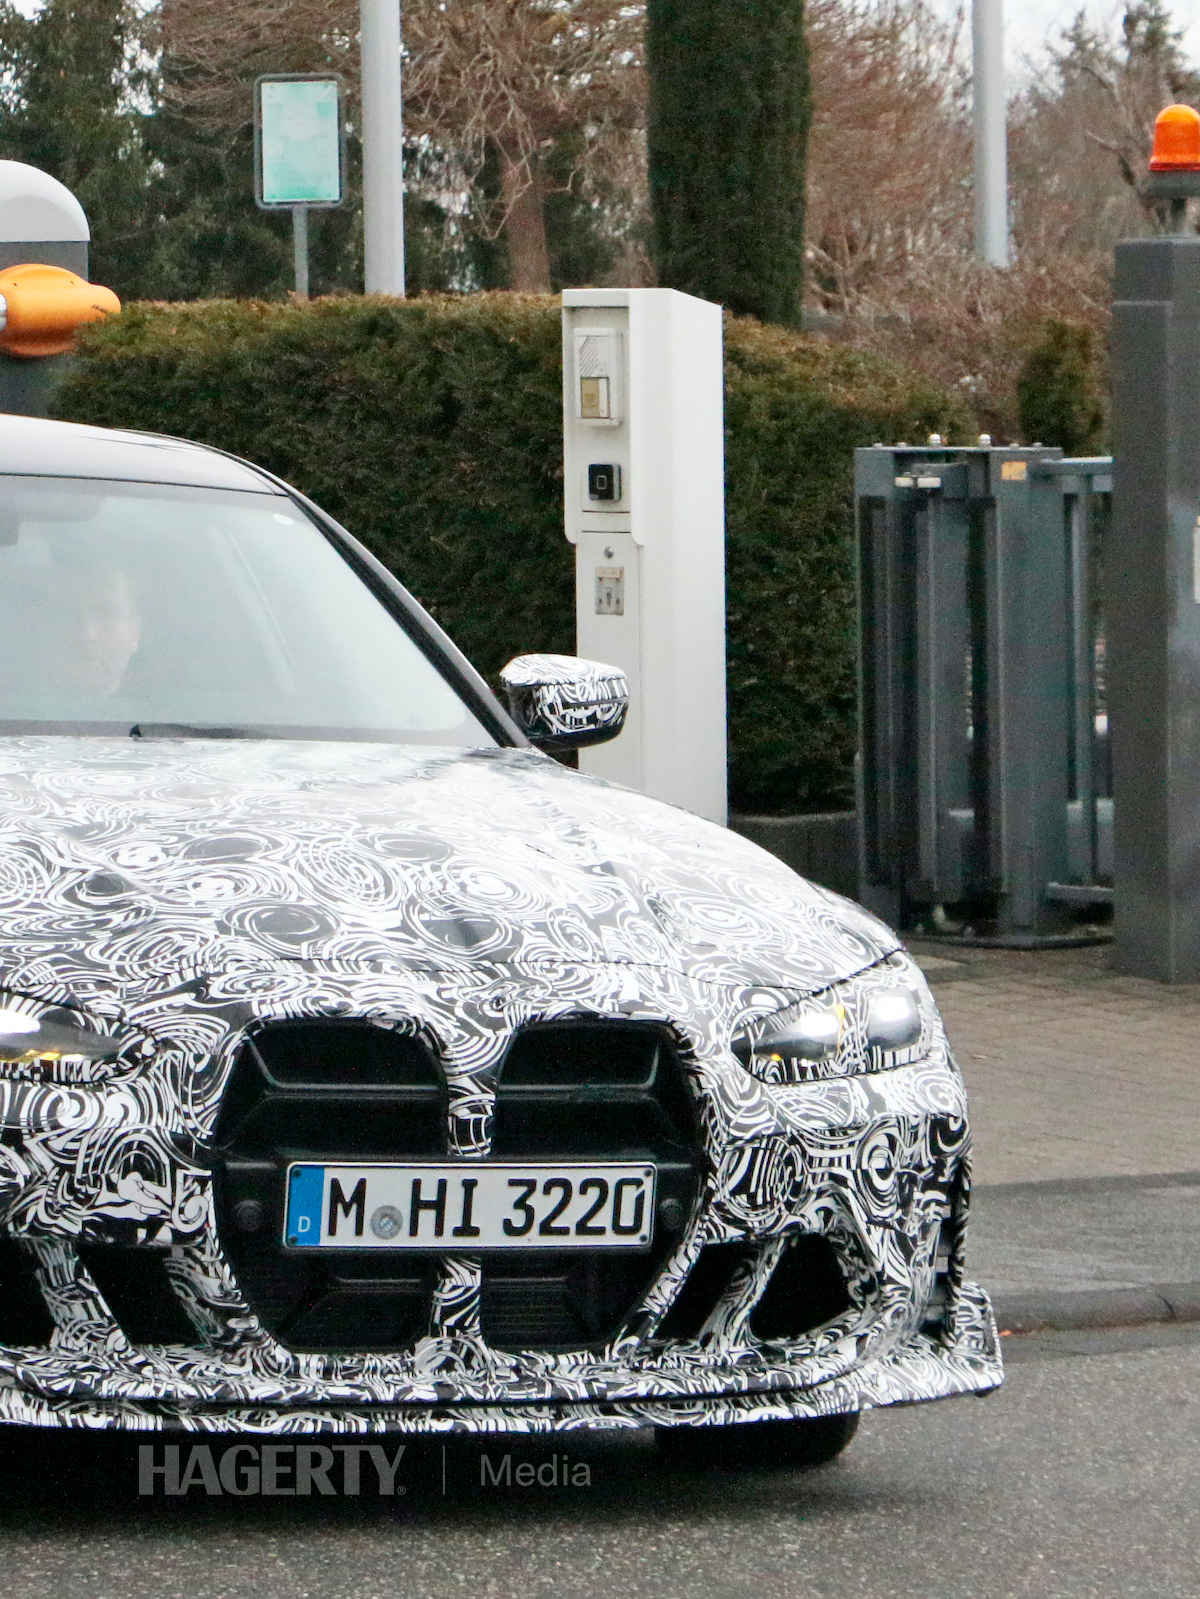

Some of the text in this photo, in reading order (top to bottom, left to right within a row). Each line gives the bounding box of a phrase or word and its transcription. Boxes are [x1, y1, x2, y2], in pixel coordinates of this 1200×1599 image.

[298, 1216, 311, 1232] D
[328, 1178, 646, 1237] M HI 3220
